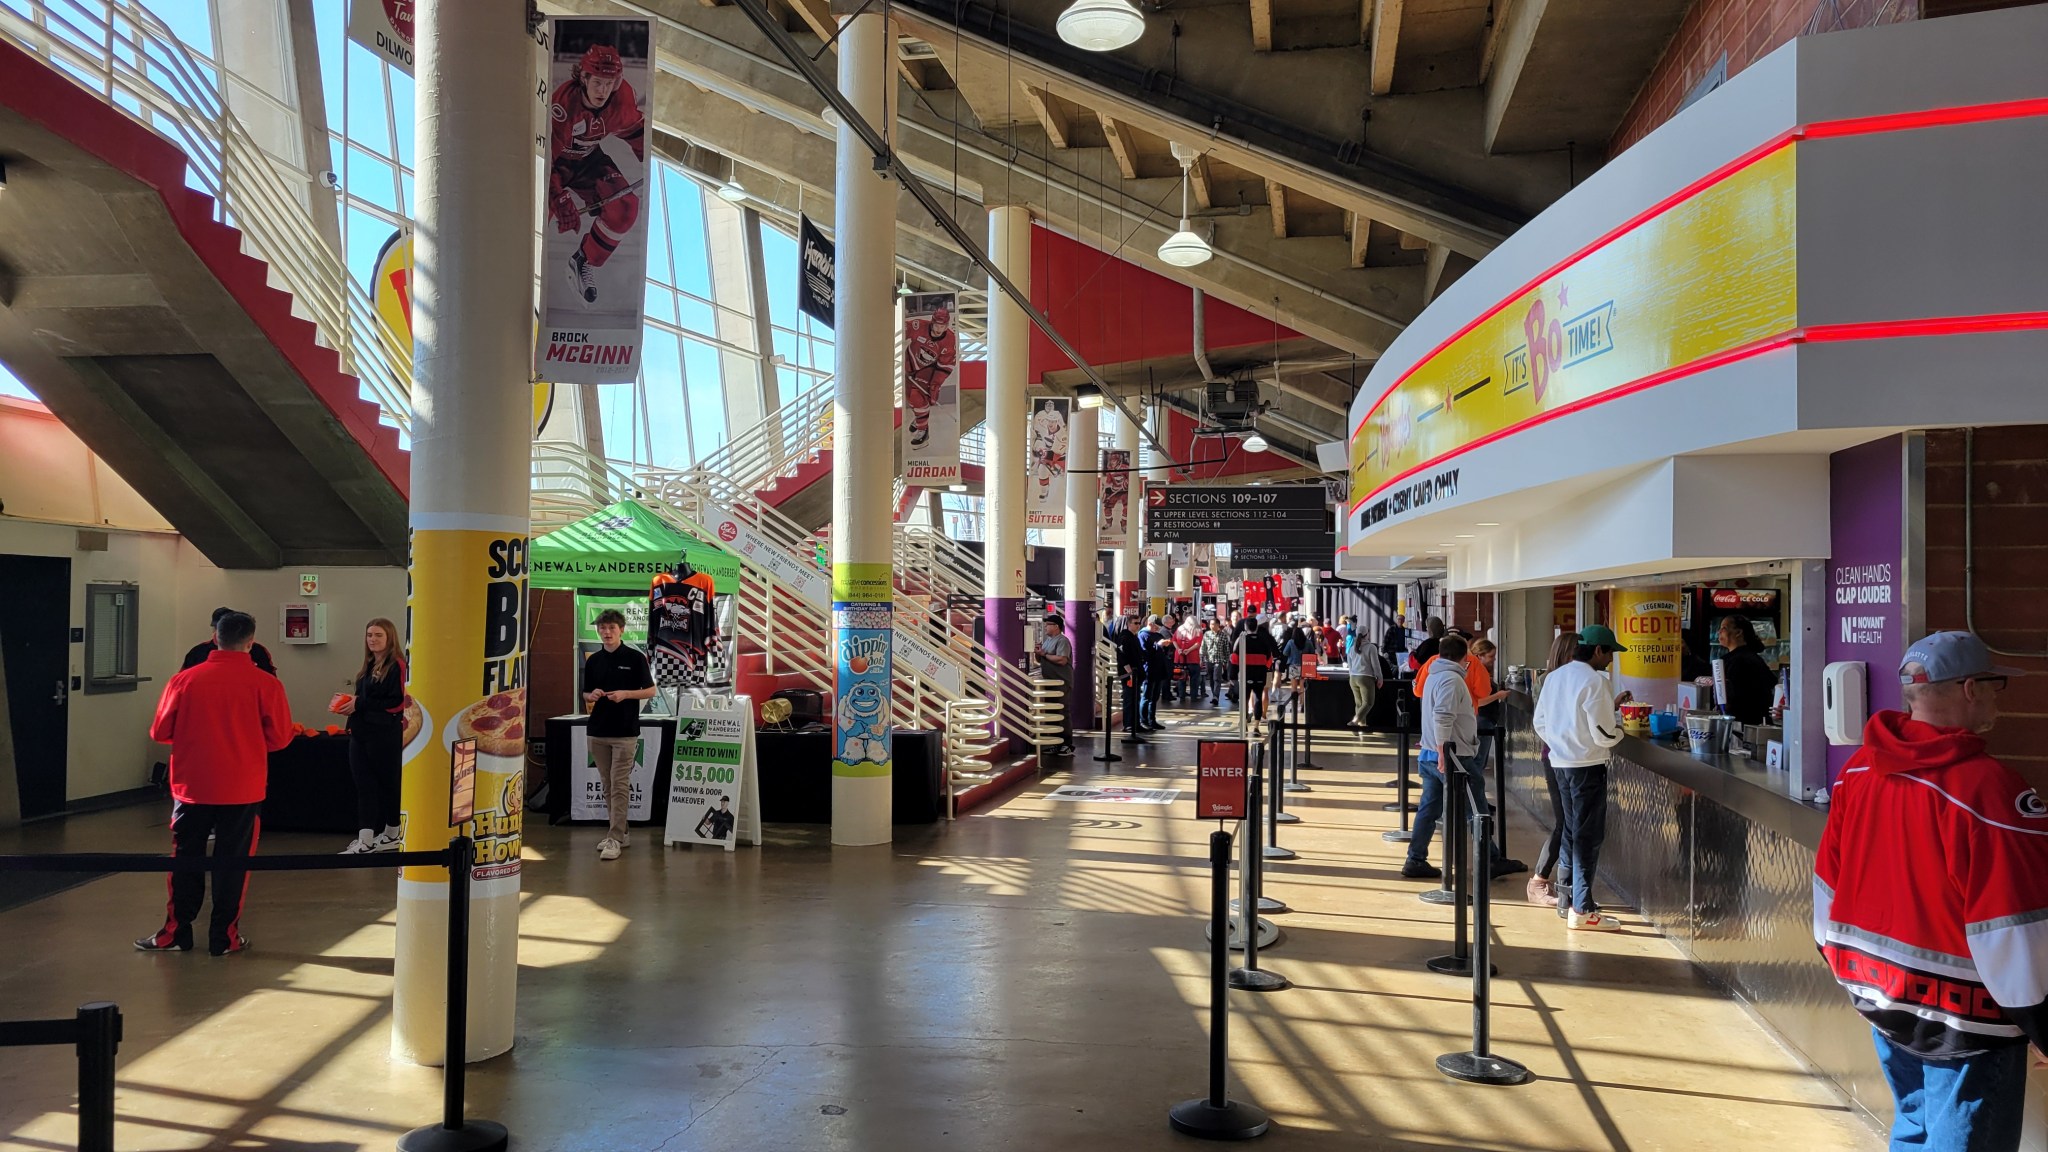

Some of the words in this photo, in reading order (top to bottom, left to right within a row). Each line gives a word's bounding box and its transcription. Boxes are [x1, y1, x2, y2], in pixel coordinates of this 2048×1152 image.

[377, 31, 415, 66] DILWO
[552, 332, 589, 343] BROCK
[1512, 352, 1526, 384] IT'S
[1568, 316, 1600, 358] TIME!
[907, 466, 956, 478] JORDAN
[1434, 468, 1459, 500] ONLY
[1169, 494, 1227, 504] SECTIONS
[1028, 515, 1064, 524] SUTTER
[745, 533, 763, 548] WHERE
[764, 545, 776, 556] NEW
[777, 554, 799, 572] FRIENDS
[799, 569, 814, 582] MEET.
[529, 561, 582, 573] NEWAL
[585, 562, 596, 573] by
[598, 562, 672, 574] ANDERSEN
[1836, 566, 1860, 584] CLEAN
[1862, 563, 1891, 583] HANDS
[1714, 594, 1737, 602] Coca-Cola
[1836, 587, 1856, 604] CLAP
[1858, 585, 1891, 603] LOUDER
[1643, 603, 1674, 611] LEGENDARY
[1624, 617, 1660, 634] ICED
[1664, 616, 1682, 633] TE
[1858, 616, 1884, 629] NOVANT
[1858, 631, 1882, 644] HEALTH
[895, 631, 908, 643] NEW
[908, 640, 932, 659] FRIENDS
[931, 656, 947, 670] MEET.
[1629, 644, 1660, 653] STEEPED
[1661, 644, 1674, 652] LIKE
[1643, 654, 1667, 664] MEAN
[1668, 654, 1674, 664] IT
[709, 719, 740, 727] RENEWAL
[677, 746, 704, 757] ENTER
[706, 747, 717, 757] TO
[717, 748, 738, 759] WIN!
[675, 763, 735, 785] $15,000
[1202, 767, 1243, 777] ENTER
[673, 785, 699, 794] WINDOW
[700, 787, 704, 795] &
[705, 788, 722, 796] DOOR
[672, 796, 705, 806] MAKEOVER
[476, 868, 511, 878] FLAVORED
